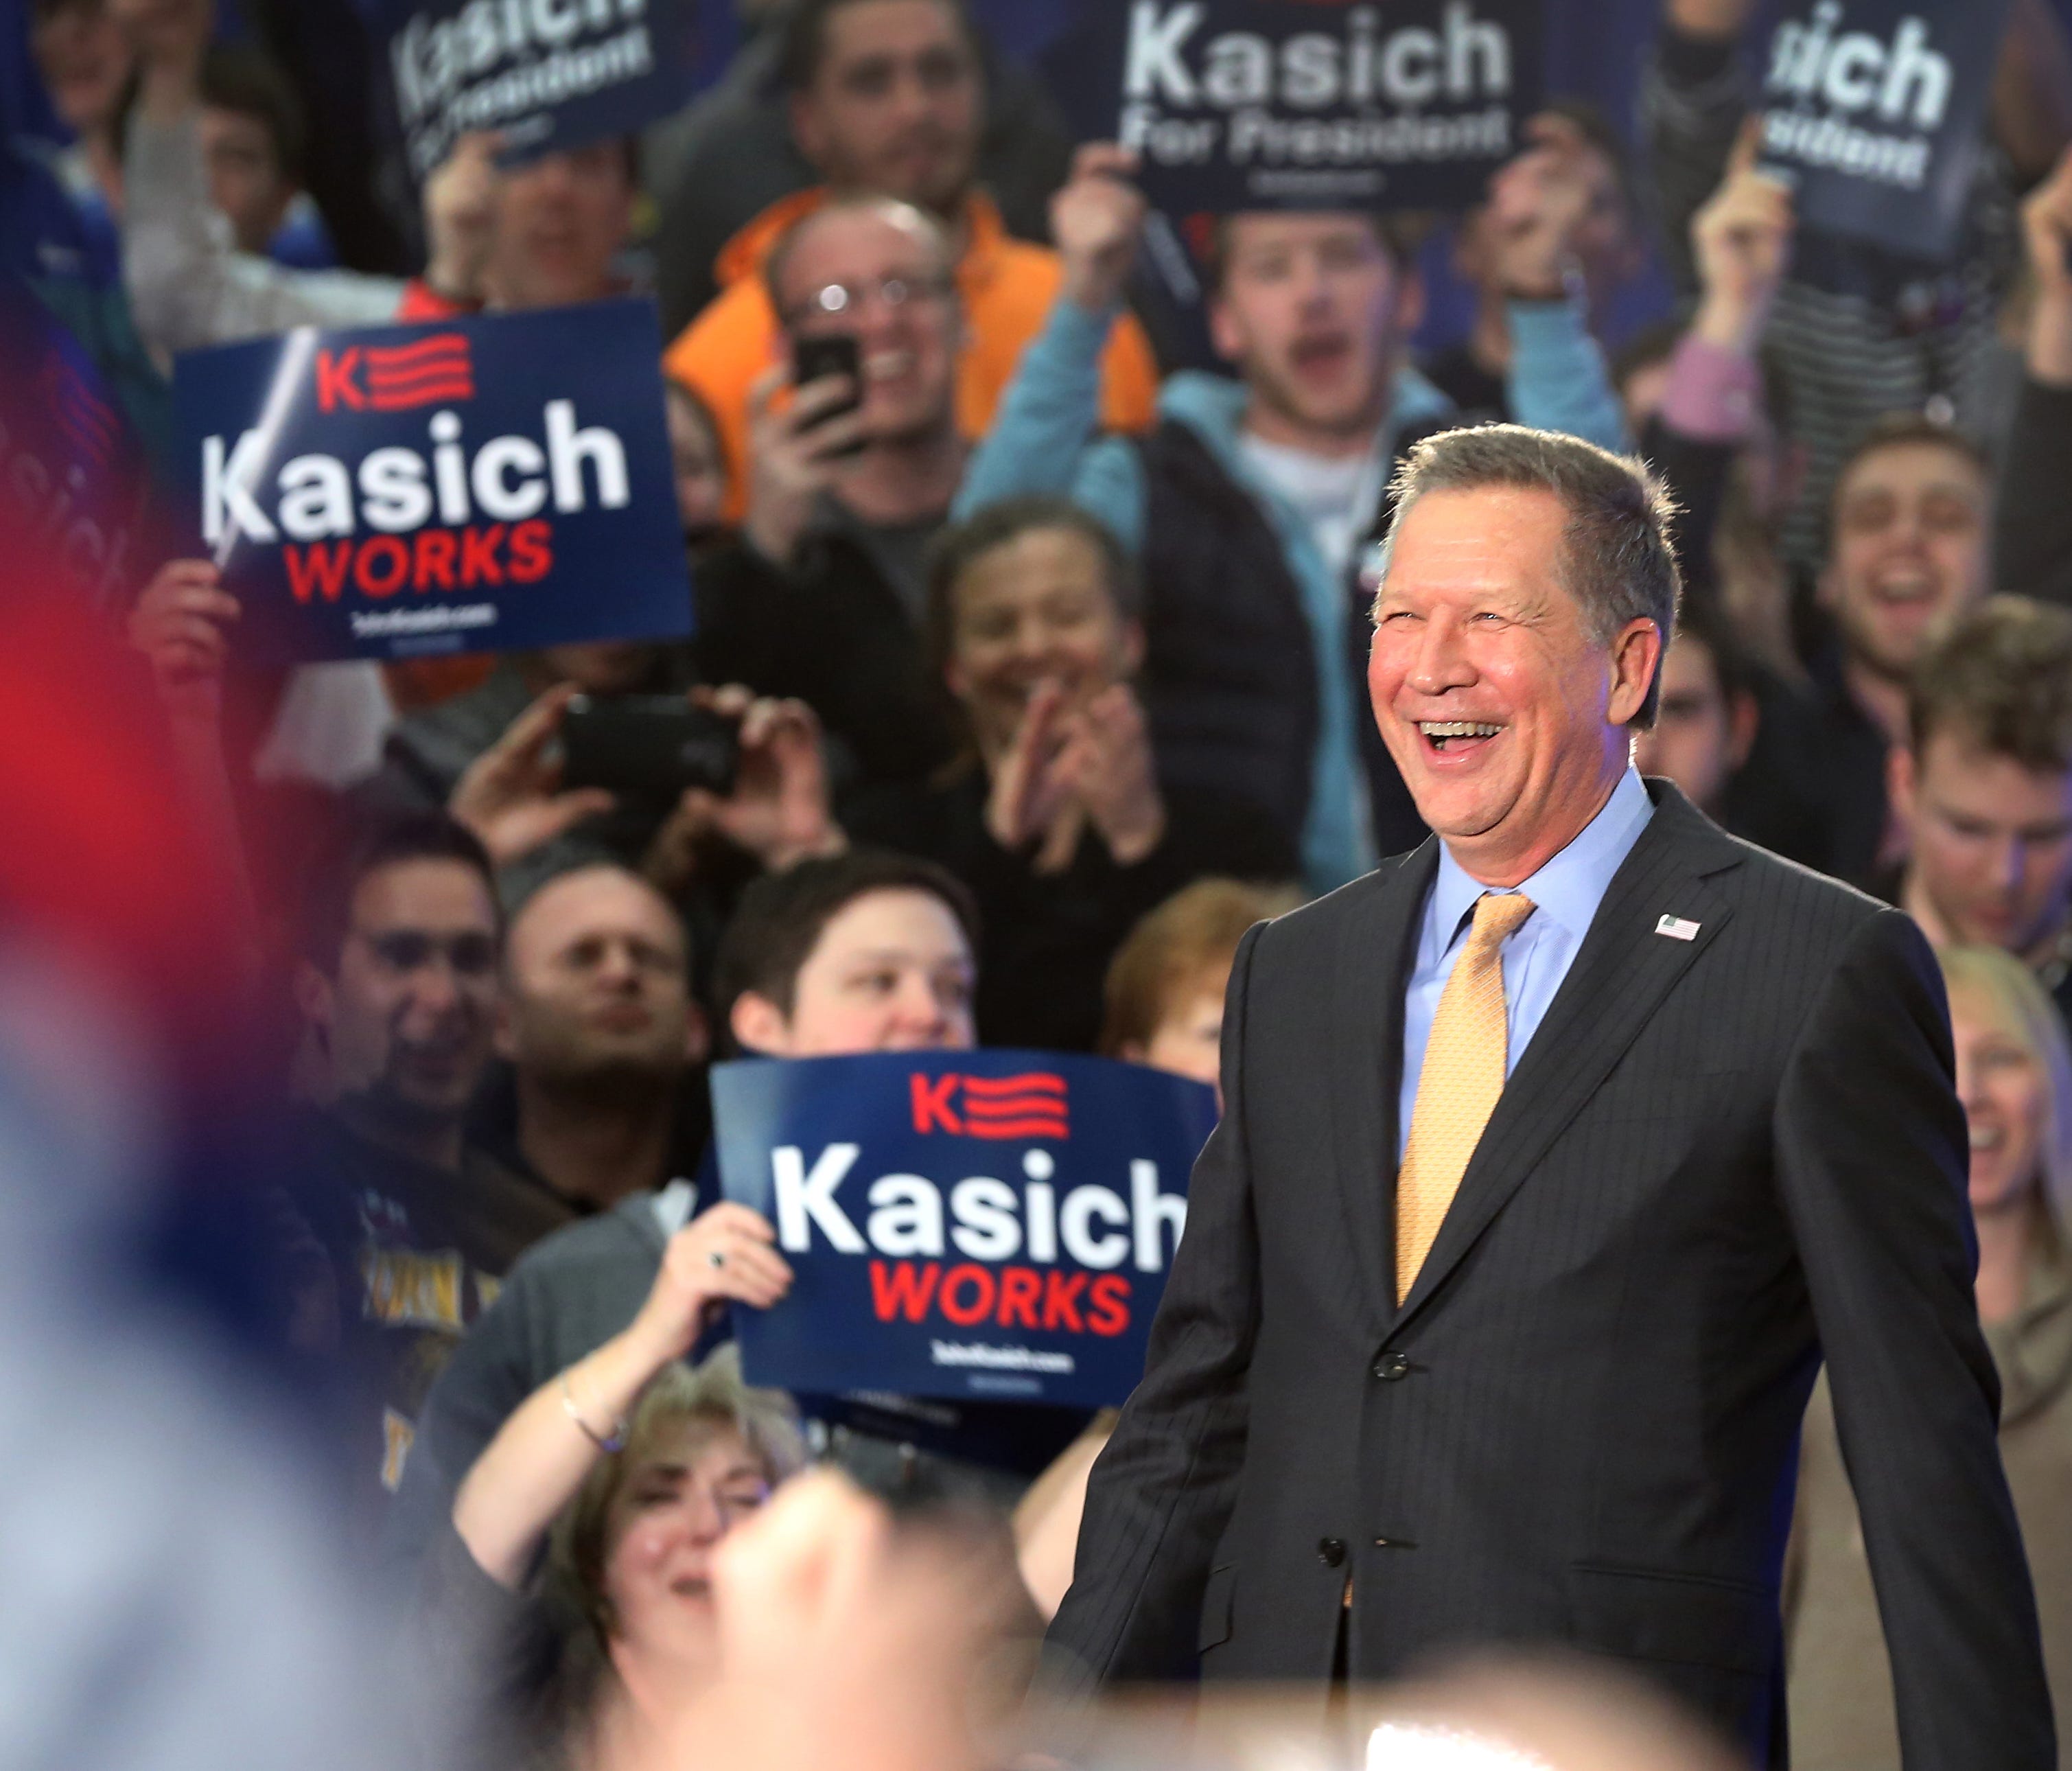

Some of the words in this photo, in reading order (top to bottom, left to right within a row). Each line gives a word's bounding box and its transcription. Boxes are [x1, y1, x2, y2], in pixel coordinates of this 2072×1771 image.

[1124, 0, 1510, 106] Kasich
[1120, 103, 1215, 165] For
[1231, 104, 1511, 165] President
[201, 398, 631, 546] Kasich
[283, 519, 555, 604] WORKS
[771, 1142, 1189, 1273] Kasich
[868, 1260, 1132, 1336] WORKS
